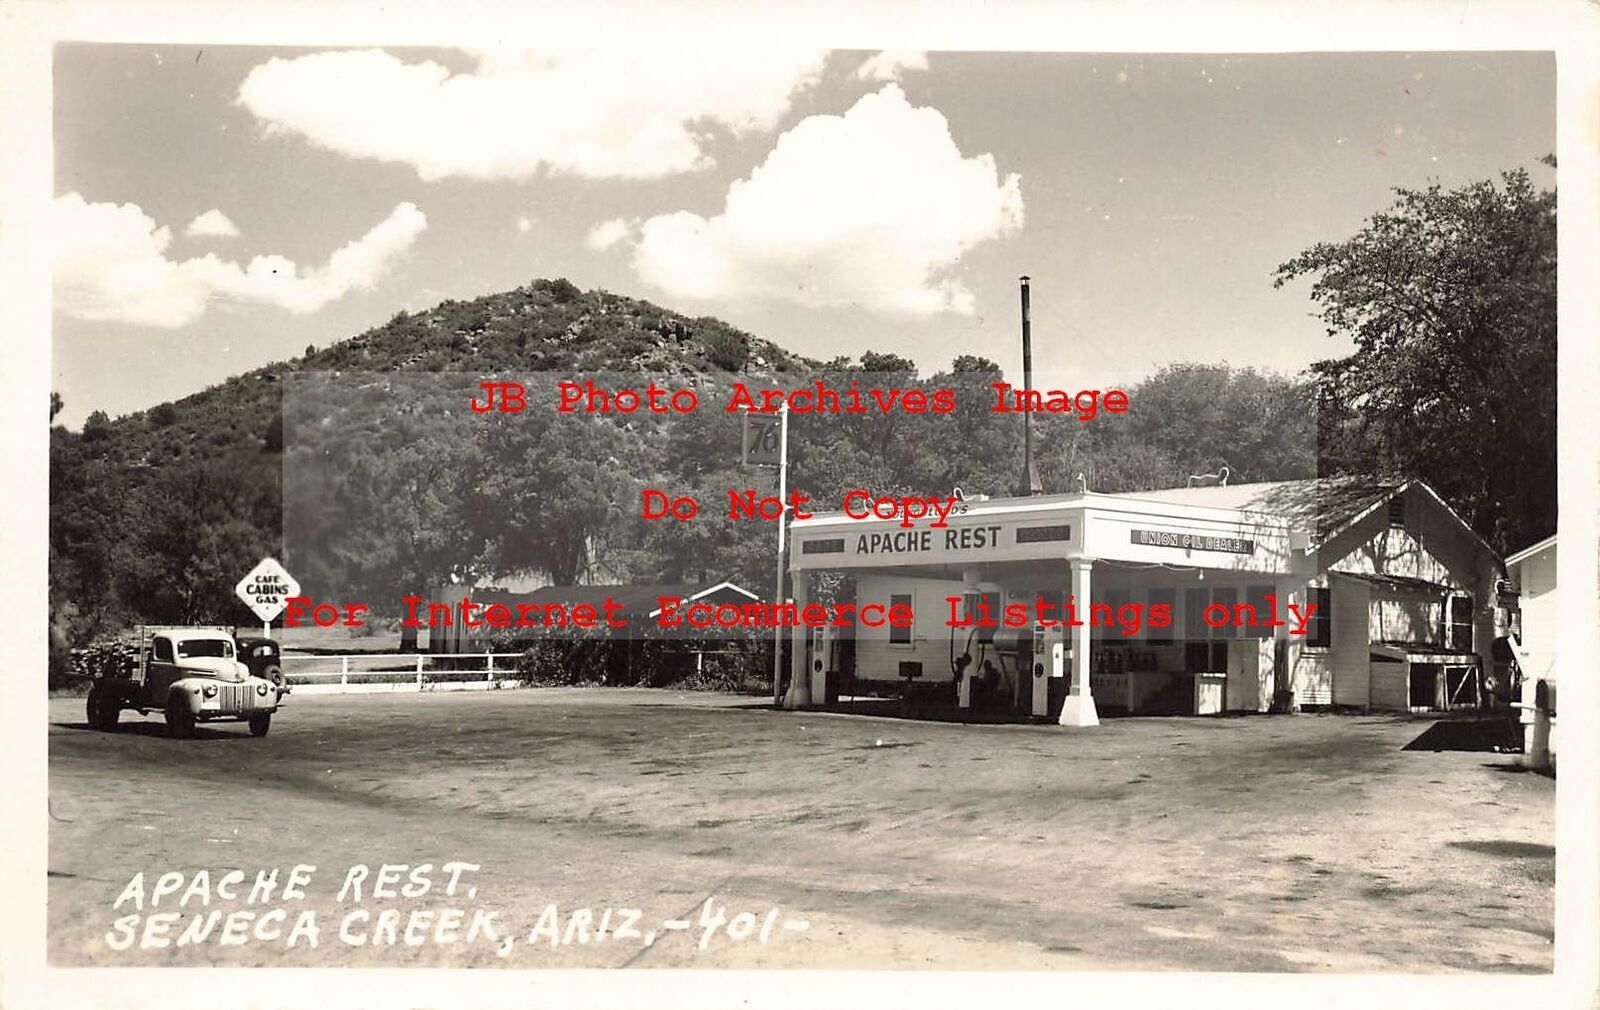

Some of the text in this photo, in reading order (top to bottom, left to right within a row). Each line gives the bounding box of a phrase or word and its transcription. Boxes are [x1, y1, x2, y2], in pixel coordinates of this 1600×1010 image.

[749, 421, 780, 454] 76
[857, 530, 932, 555] APACHE
[944, 526, 1002, 550] REST
[1140, 530, 1178, 546] UNION
[1182, 533, 1204, 549] OIL
[255, 575, 280, 584] CAFE
[246, 584, 289, 595] CABINS
[256, 596, 279, 604] GAS
